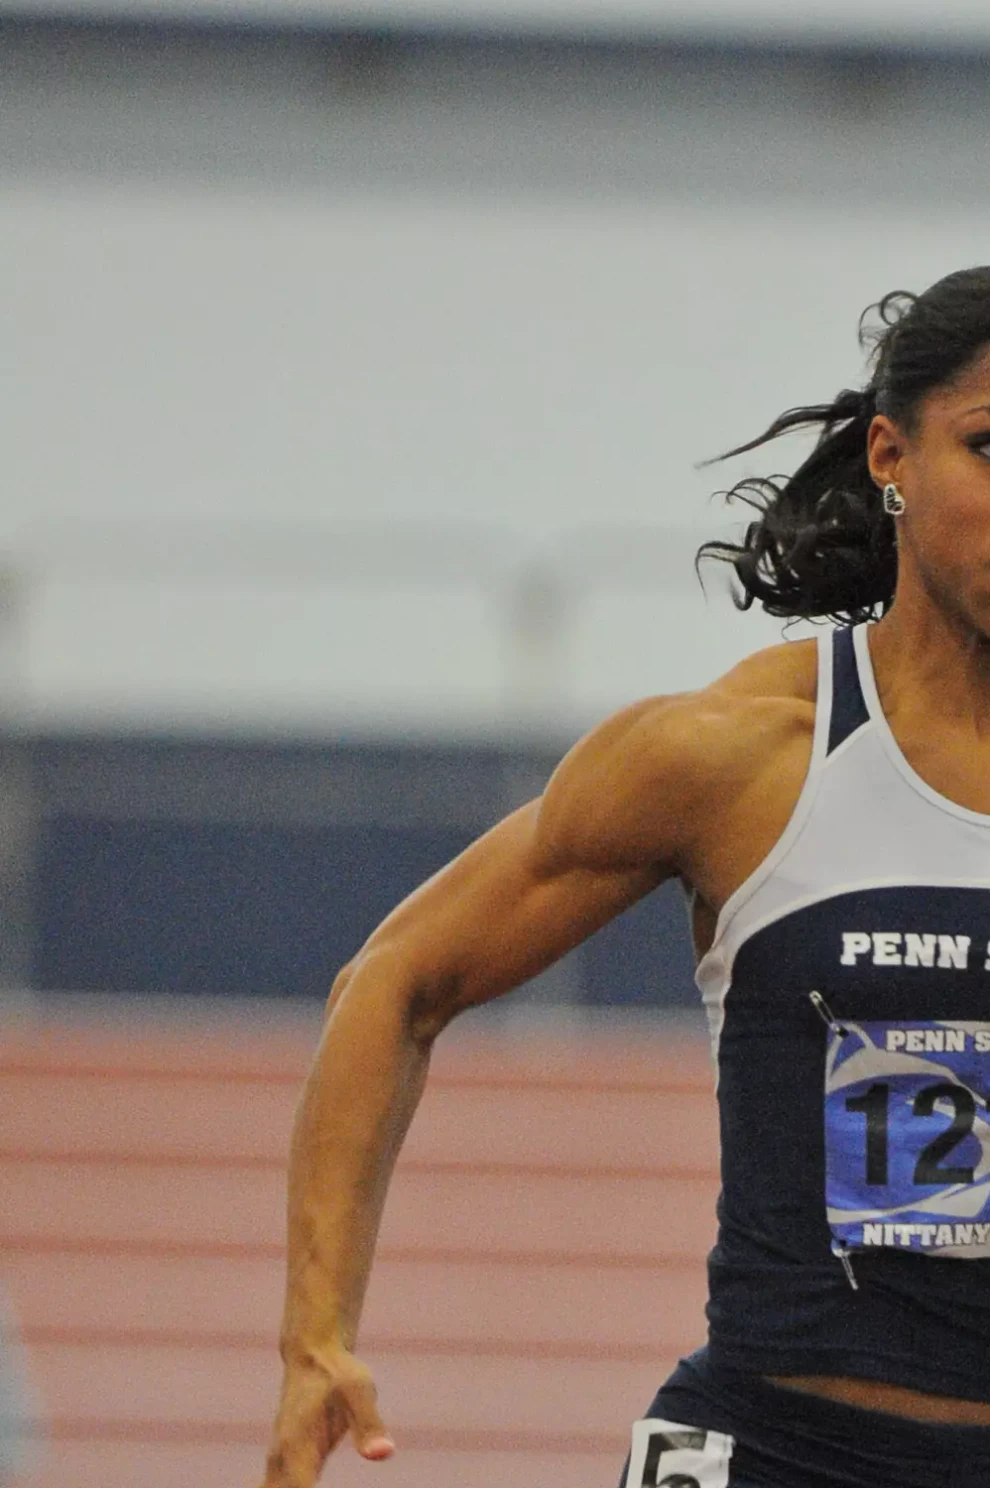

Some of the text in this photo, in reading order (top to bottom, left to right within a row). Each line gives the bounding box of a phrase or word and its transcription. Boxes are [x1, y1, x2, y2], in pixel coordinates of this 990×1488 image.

[840, 932, 971, 969] PENN
[886, 1031, 966, 1053] PENN
[862, 1222, 990, 1247] NITTANY
